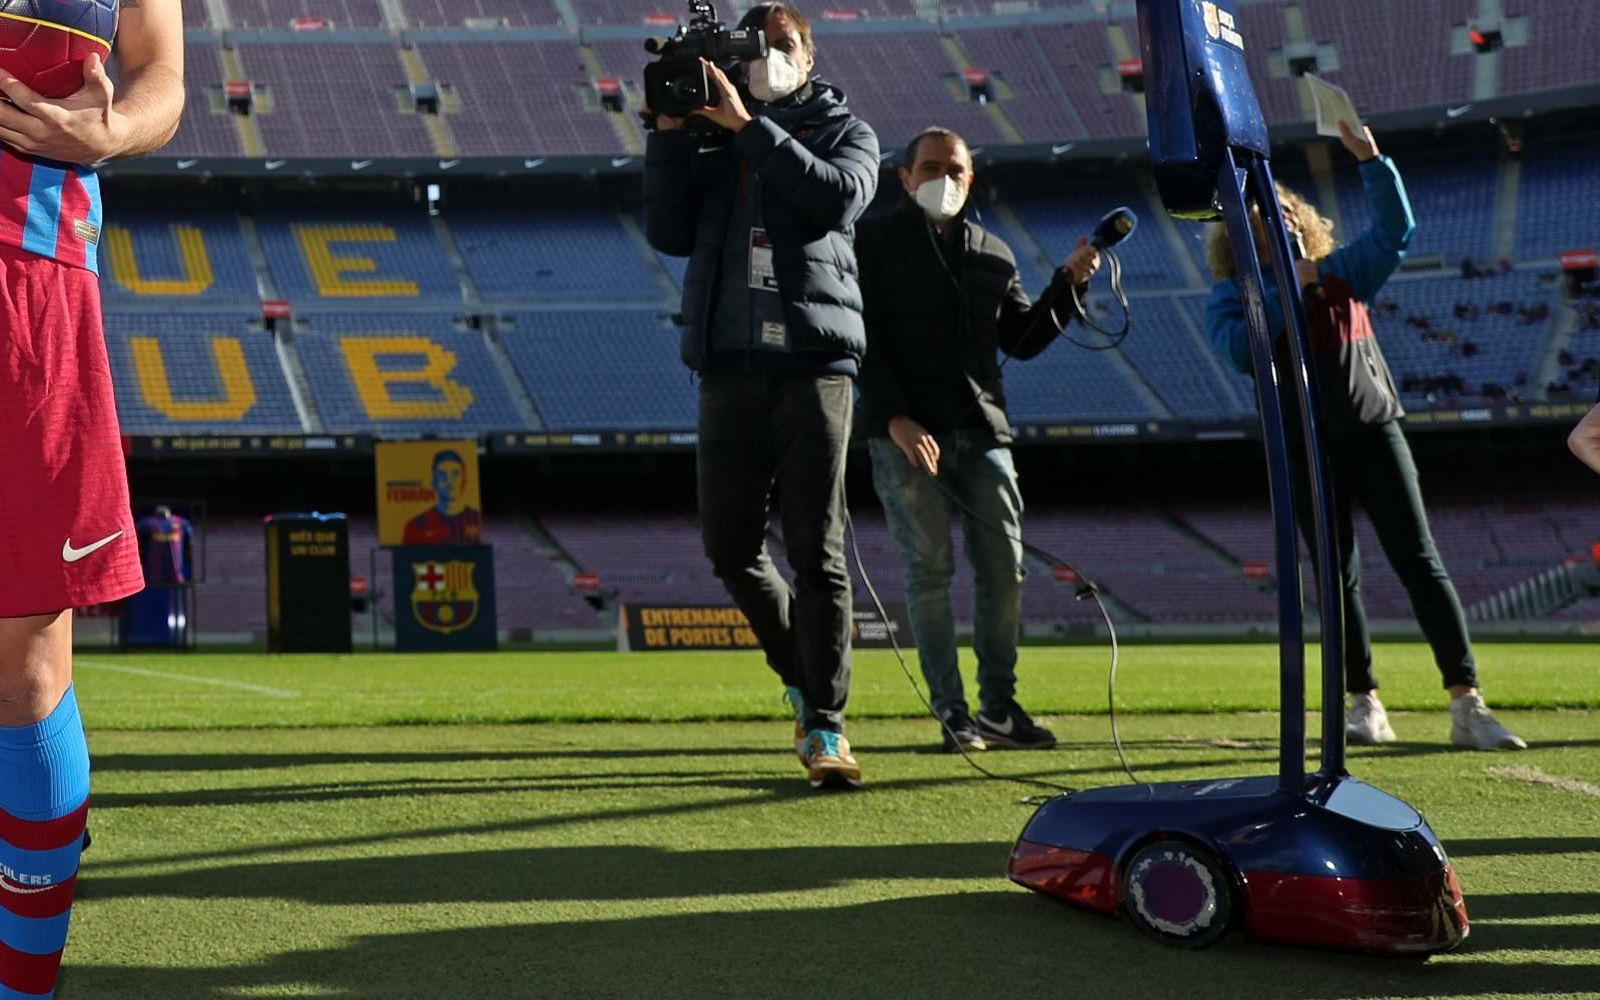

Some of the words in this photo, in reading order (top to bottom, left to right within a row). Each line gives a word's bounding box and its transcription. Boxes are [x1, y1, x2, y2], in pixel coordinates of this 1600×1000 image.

[104, 224, 420, 296] UE
[131, 336, 475, 421] UB
[640, 608, 750, 626] ENTRENAMEN
[645, 628, 667, 646] DE
[670, 628, 731, 646] PORTES
